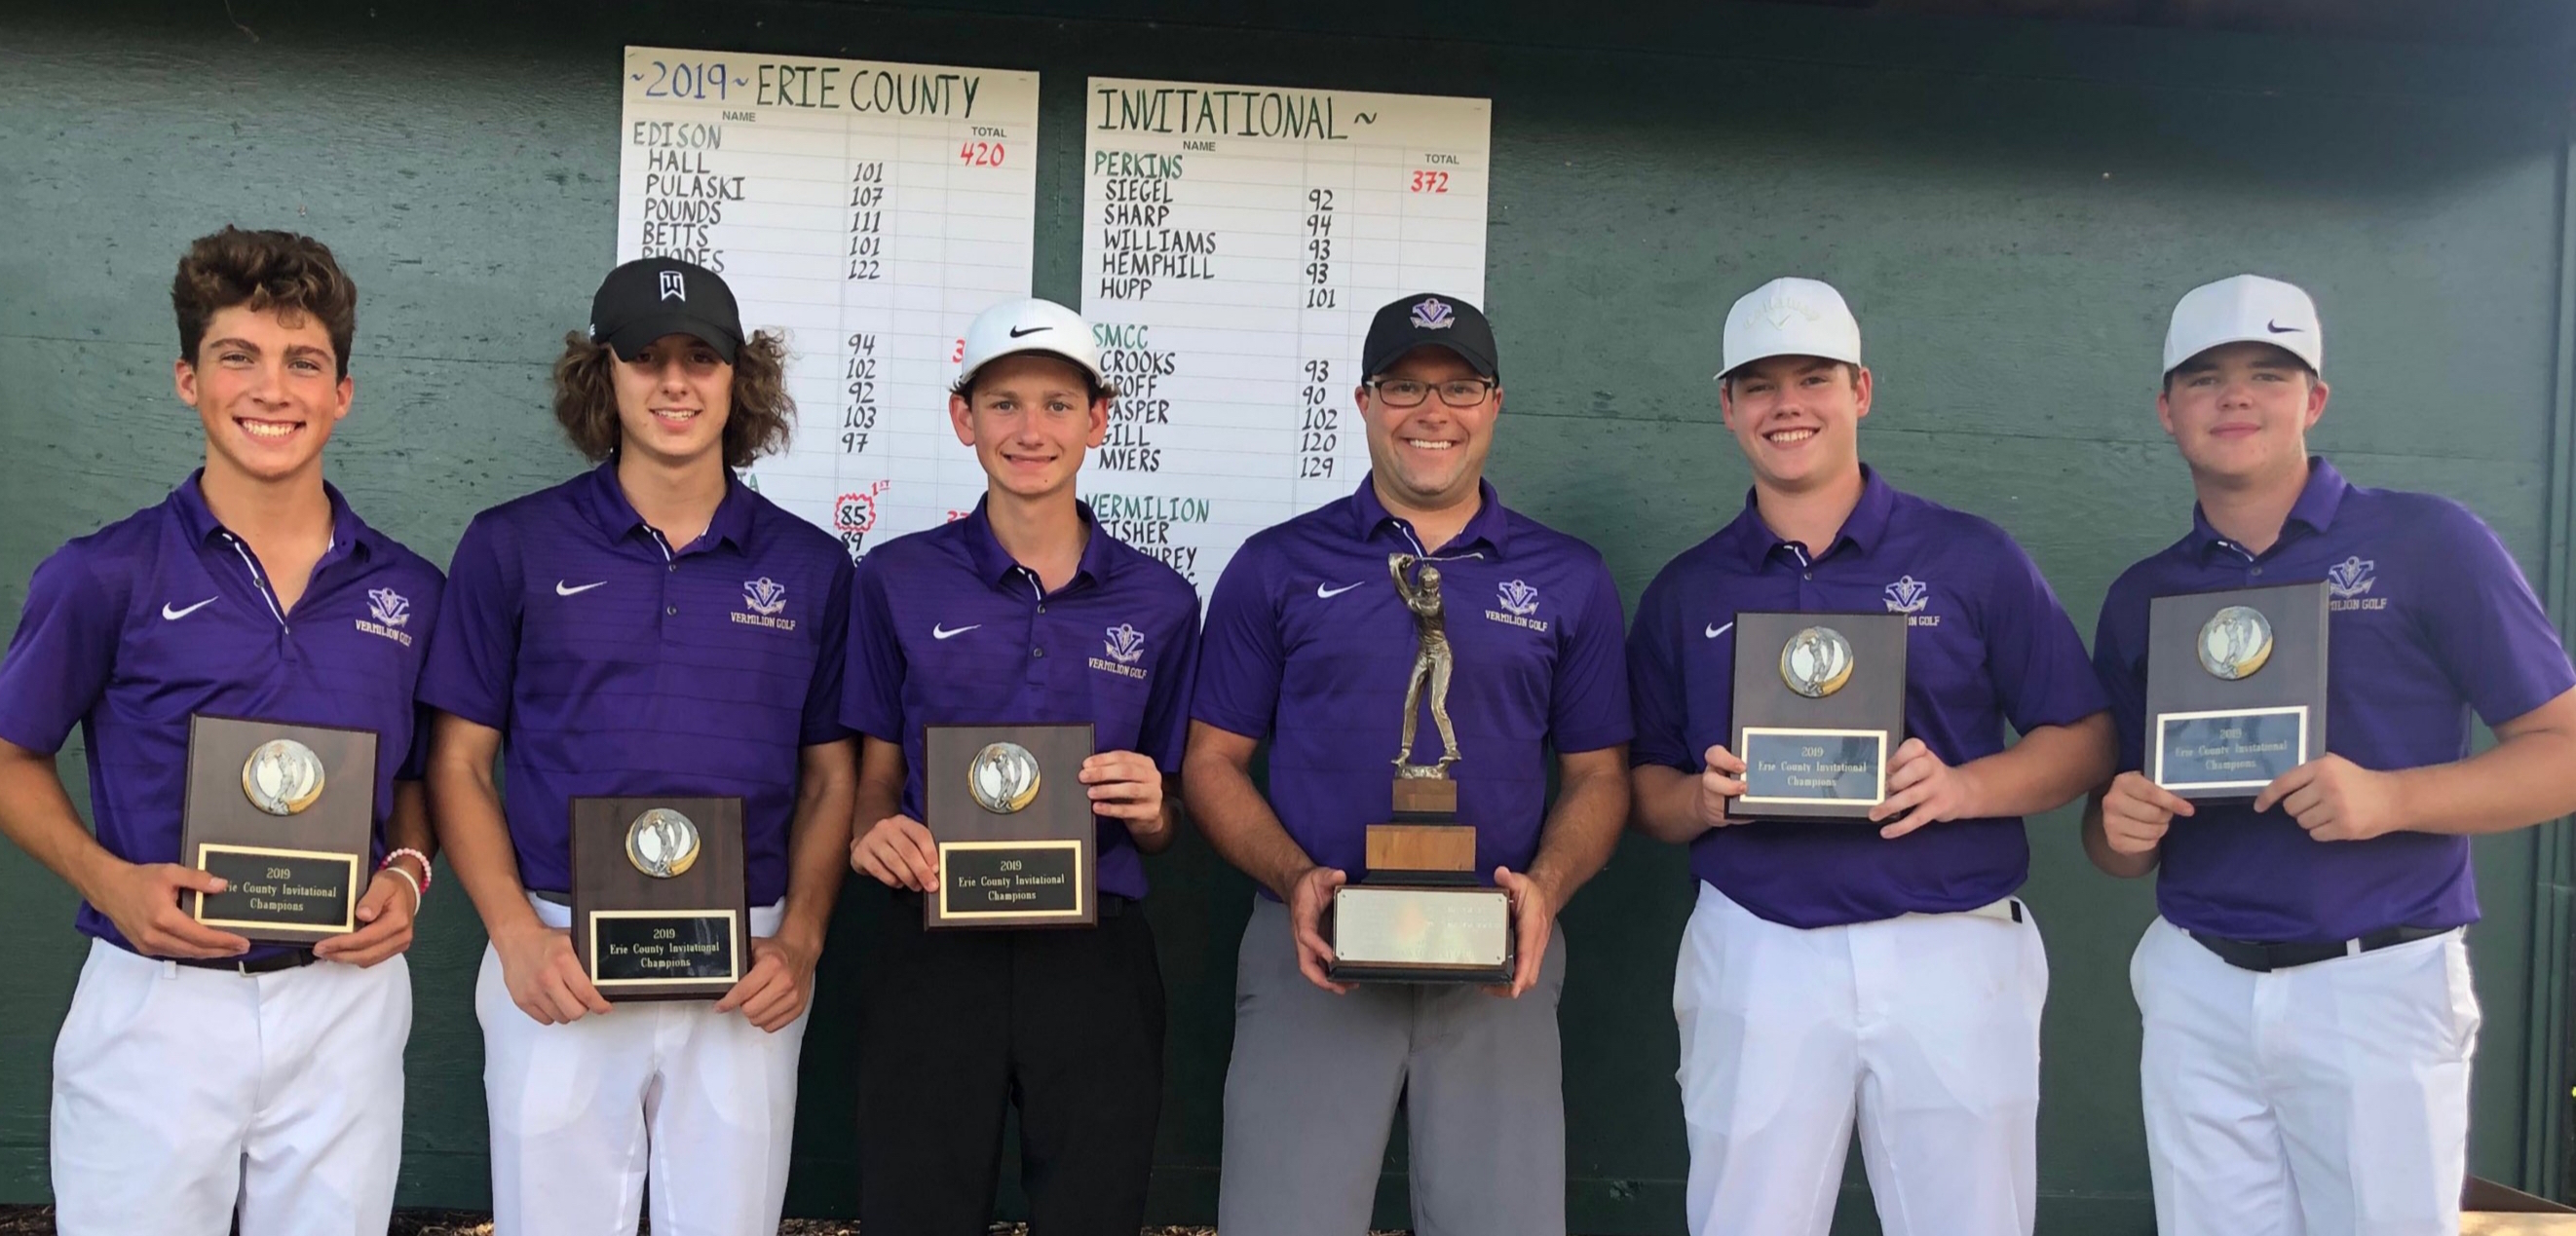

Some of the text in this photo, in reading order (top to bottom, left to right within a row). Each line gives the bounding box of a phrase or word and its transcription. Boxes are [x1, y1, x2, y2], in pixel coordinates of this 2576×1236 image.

[756, 64, 841, 108] ERIE
[851, 69, 979, 119] COUNTY
[722, 110, 1007, 137] NAME TOTAL
[633, 121, 1004, 168] EDISON 420
[1183, 140, 1459, 165] NAME TOTAL
[648, 149, 884, 183] HALL 101
[1093, 150, 1449, 193] PERKINS 372
[646, 173, 884, 207] PULASKI 107
[1105, 178, 1334, 210] SIEGEL 92
[644, 198, 881, 233] POUNDS 111
[1104, 204, 1332, 237] SHARP 94
[642, 222, 881, 256] BETTS 101
[1104, 228, 1331, 261] WILLIAMS 93
[848, 260, 881, 280] 122
[1103, 253, 1329, 284] HEMPHILL 93
[1100, 278, 1336, 309] HUPP 101
[848, 333, 876, 356] 94
[1092, 322, 1149, 350] SMCC
[846, 357, 876, 380] 102
[1100, 350, 1330, 383] CROOKS 93
[848, 382, 876, 403] 92
[1302, 385, 1326, 405] 90
[844, 405, 877, 429] 103
[1108, 398, 1338, 431] ASPER 102
[841, 432, 869, 453] 97
[1301, 432, 1337, 453] 120
[1098, 447, 1334, 479] MYERS 129
[841, 505, 867, 526] 85
[1085, 493, 1210, 523] VERMILION
[841, 532, 864, 552] 89
[2362, 597, 2388, 611] GOLF
[355, 618, 399, 641] VERMILION
[731, 611, 796, 631] VERMILION GOLF
[1485, 609, 1548, 633] VERMILION GOLF
[1918, 615, 1941, 626] GOLF
[1088, 656, 1148, 680] VERMILION GOLF
[1801, 746, 1824, 758] 2019
[2198, 745, 2229, 757] County
[2235, 739, 2288, 754] Invitational
[1758, 761, 1867, 772] Erie County Invitational
[2206, 760, 2256, 772] Champions
[1787, 775, 1837, 788] Champions
[266, 867, 291, 880] 2019
[1000, 860, 1022, 872] 2019
[243, 880, 278, 897] County
[283, 883, 337, 898] Invitational
[958, 873, 1065, 888] Erie County Invitational
[249, 897, 304, 913] Champions
[988, 890, 1037, 903] Champions
[653, 928, 676, 940] 2019
[610, 941, 720, 955] Erie County Invitational
[640, 956, 691, 970] Champions
